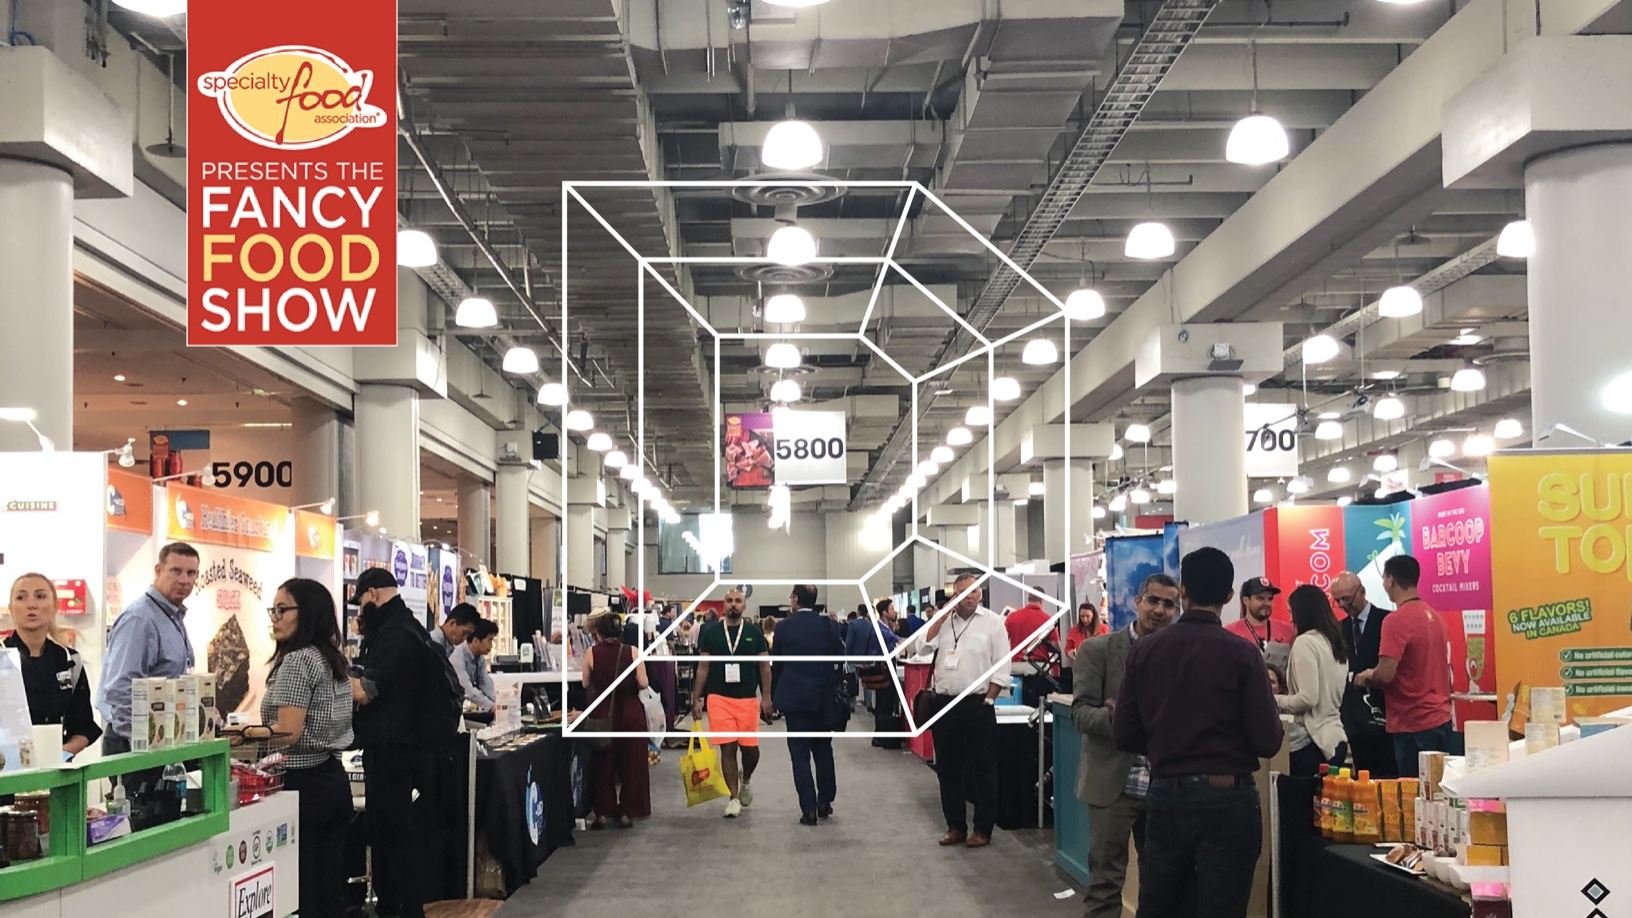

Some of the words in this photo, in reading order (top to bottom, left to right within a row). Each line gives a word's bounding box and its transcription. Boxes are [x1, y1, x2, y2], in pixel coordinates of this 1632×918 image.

[776, 437, 844, 460] 5800
[212, 460, 292, 488] 5900
[1422, 517, 1484, 550] BARCOOP
[1436, 549, 1470, 576] BEVY
[229, 558, 262, 600] Seaweed
[1509, 611, 1518, 623] 6
[1521, 600, 1589, 621] FLAVORS!
[1512, 621, 1537, 632] NOW
[1539, 611, 1591, 628] AVAILABLE
[1526, 630, 1537, 638] IN
[1540, 623, 1579, 635] CANADA
[1574, 651, 1584, 659] No
[1575, 669, 1585, 677] No
[1576, 685, 1586, 693] No
[239, 881, 272, 918] Explore
